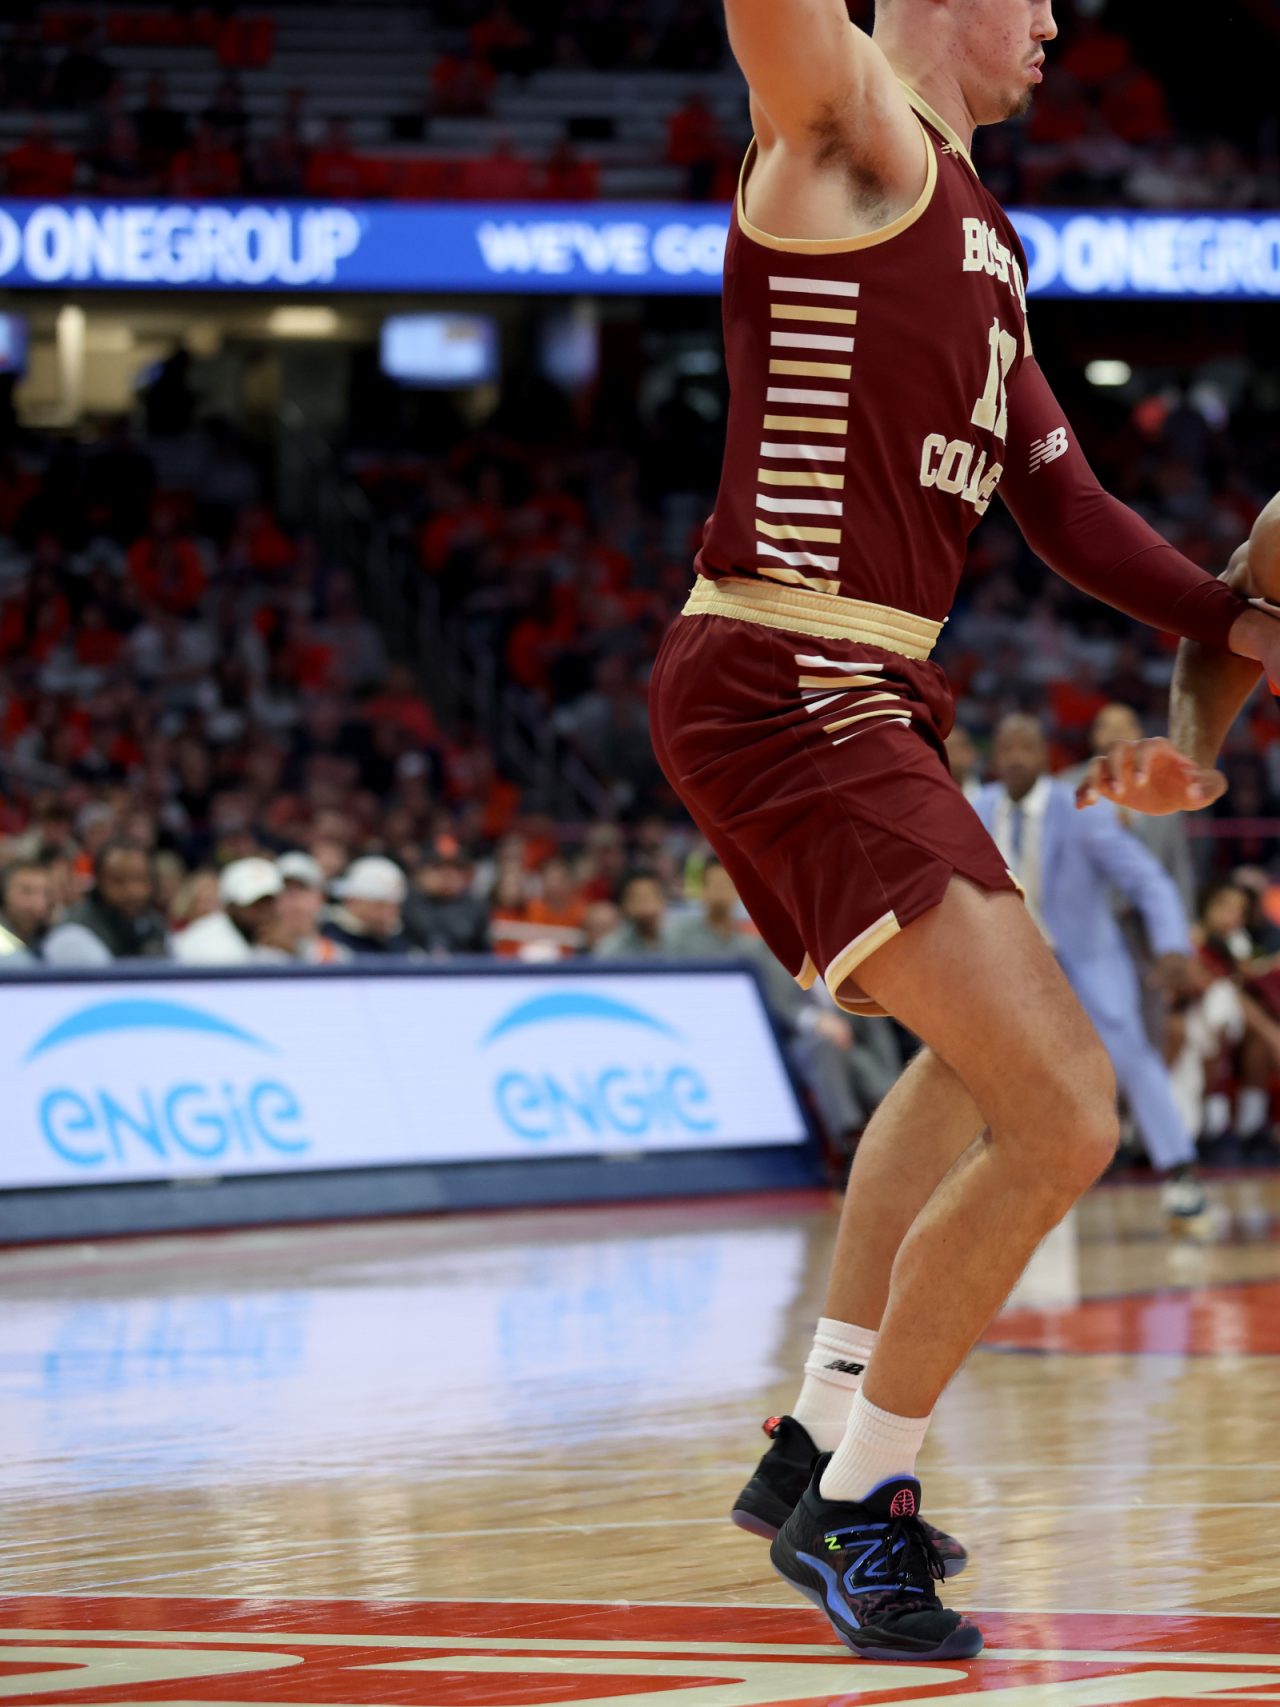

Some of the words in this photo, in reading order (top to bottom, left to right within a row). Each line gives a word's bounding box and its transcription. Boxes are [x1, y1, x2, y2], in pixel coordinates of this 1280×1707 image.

[23, 205, 362, 284] ONEGROUP
[476, 220, 649, 275] WE'VE
[652, 222, 730, 275] GO
[962, 217, 1028, 313] BOSTO
